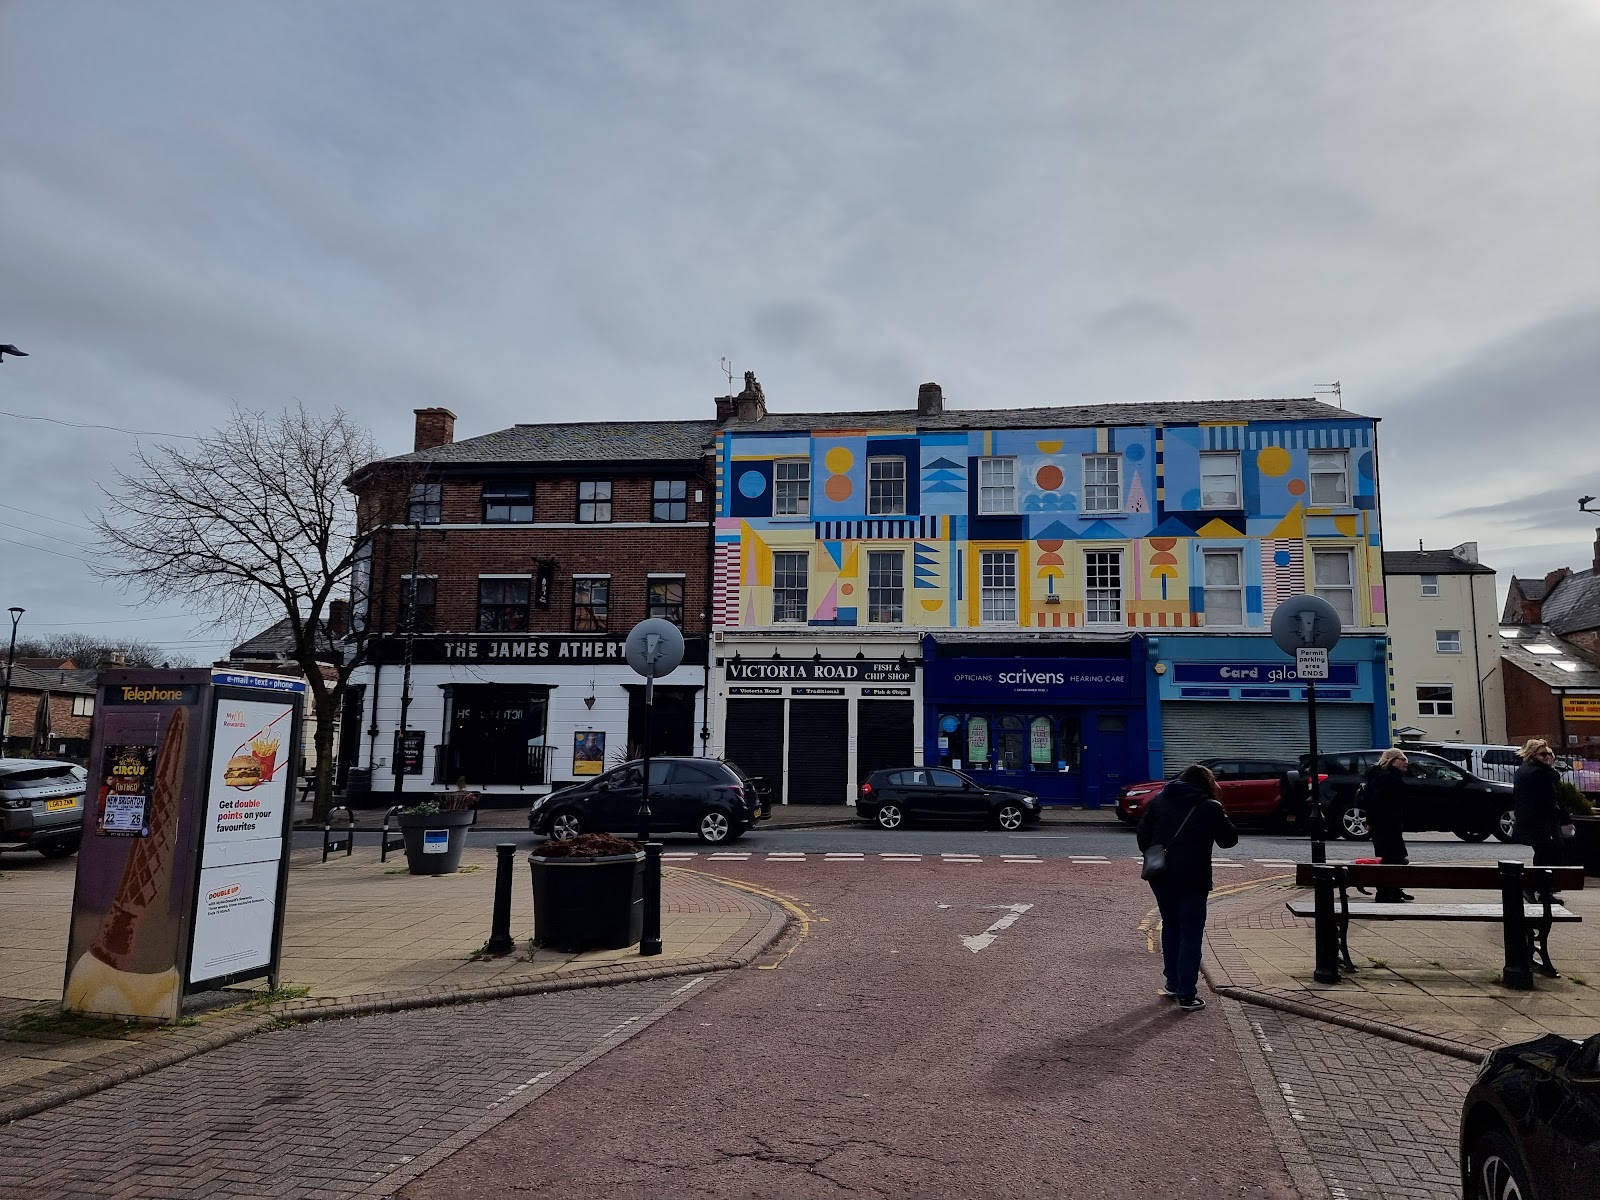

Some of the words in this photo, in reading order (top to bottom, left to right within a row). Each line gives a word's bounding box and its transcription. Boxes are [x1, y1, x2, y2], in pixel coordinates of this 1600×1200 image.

[444, 642, 478, 658] THE
[488, 642, 549, 658] JAMES
[558, 642, 627, 658] ATHERT
[730, 665, 807, 678] VICTORIA
[813, 665, 858, 678] ROAD
[954, 674, 993, 682] OPTICIANS
[998, 668, 1065, 684] scrivens
[1069, 675, 1103, 683] HEARING
[1104, 675, 1125, 683] CARE
[1219, 666, 1259, 679] Card
[1267, 664, 1297, 683] galo
[226, 675, 249, 685] e-mail
[254, 678, 268, 687] text
[273, 681, 294, 690] phone
[121, 686, 183, 704] Telephone
[112, 765, 146, 776] CIRCUS
[107, 796, 118, 805] NEW
[118, 796, 145, 806] BRIGHTON
[219, 800, 233, 809] Get
[234, 799, 261, 809] double
[106, 813, 115, 823] 22
[131, 814, 141, 824] 26
[217, 811, 243, 823] points
[254, 811, 272, 821] your
[216, 821, 256, 833] favourites
[208, 888, 231, 900] DOUBLE
[231, 886, 239, 894] UP
